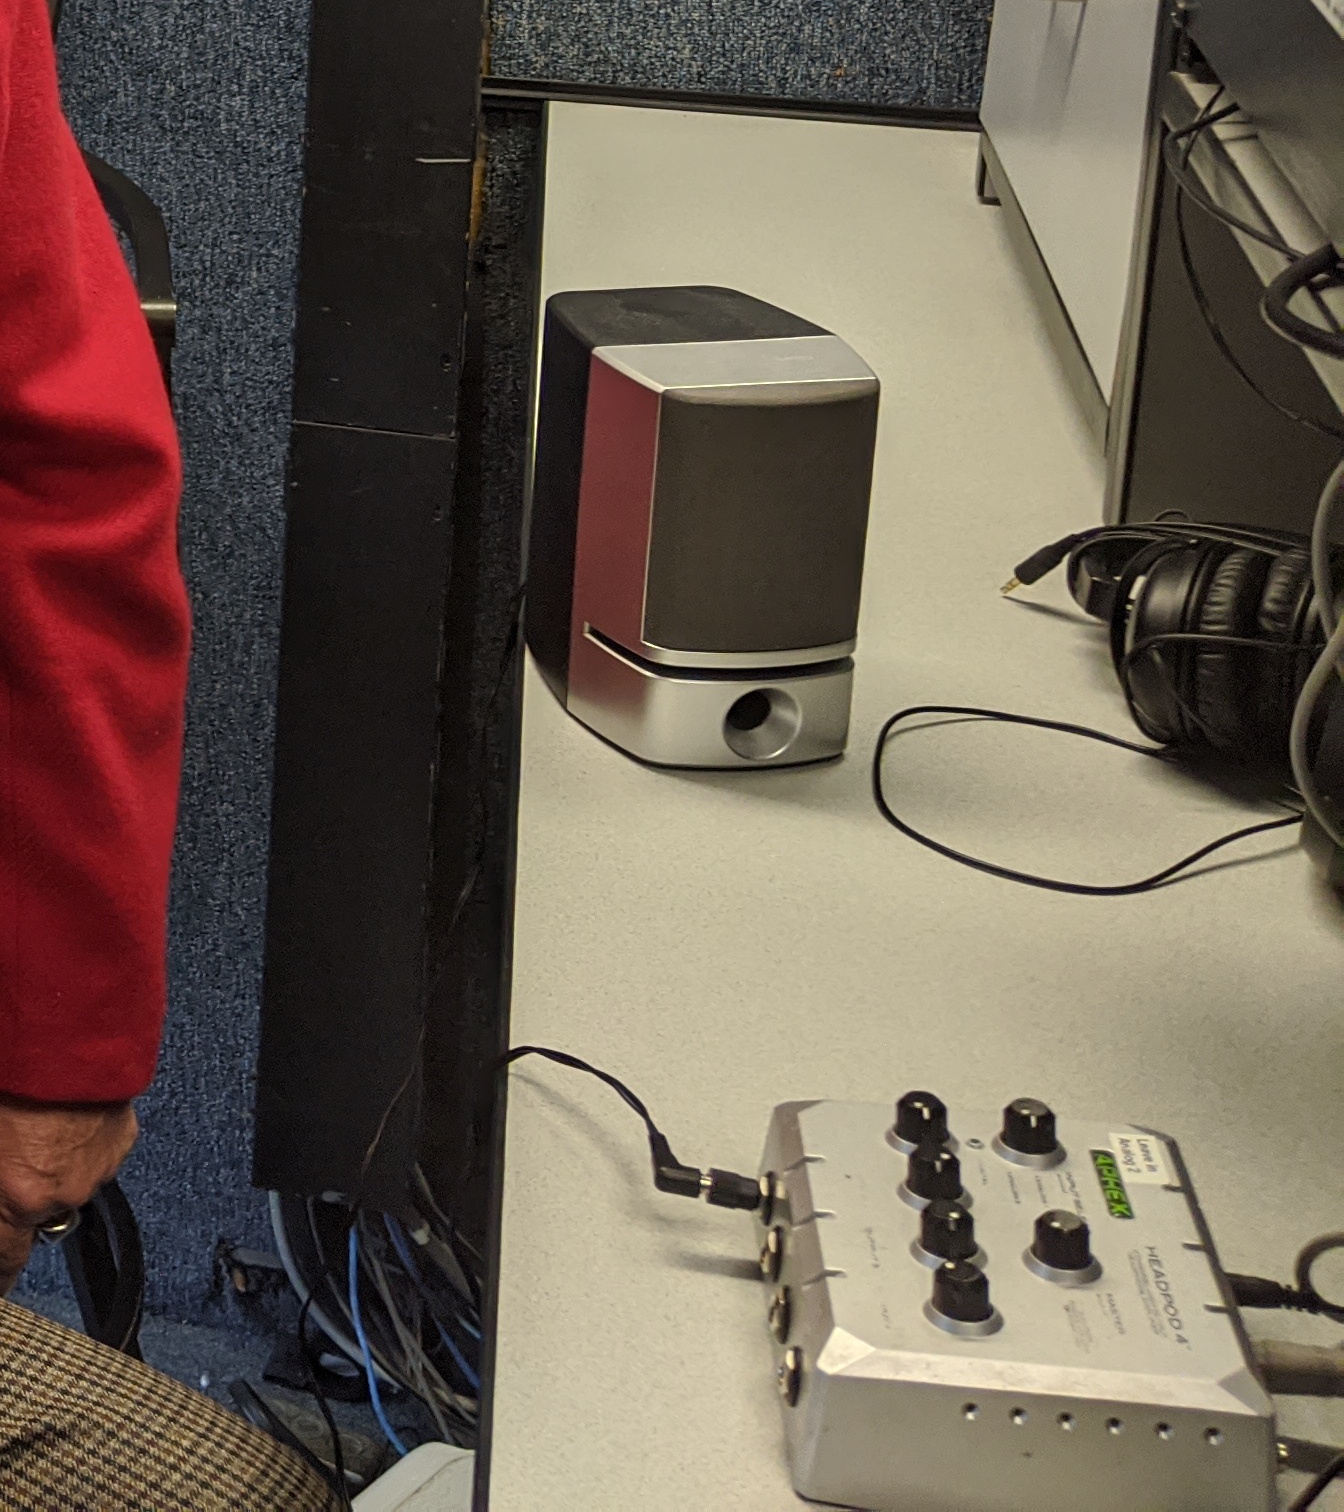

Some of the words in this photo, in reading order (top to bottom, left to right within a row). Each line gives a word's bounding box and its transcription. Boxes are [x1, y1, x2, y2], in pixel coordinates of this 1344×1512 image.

[1118, 1137, 1136, 1166] Analog
[1136, 1138, 1154, 1163] Leave
[1146, 1164, 1158, 1172] in
[1095, 1152, 1131, 1217] APHEX
[1146, 1246, 1184, 1330] HEADPOD
